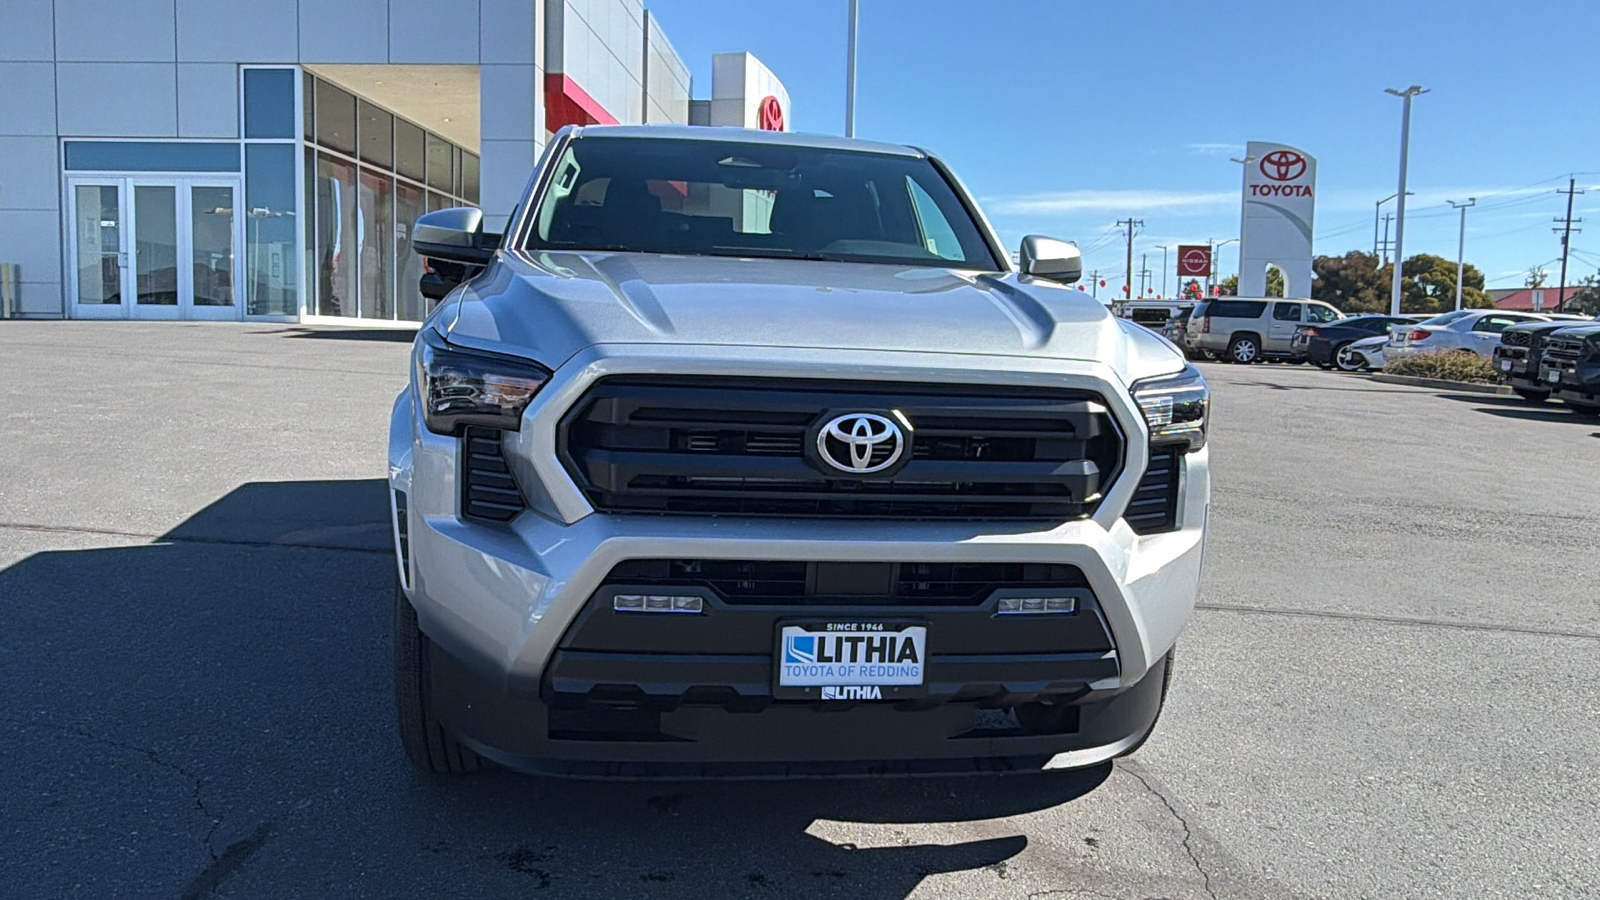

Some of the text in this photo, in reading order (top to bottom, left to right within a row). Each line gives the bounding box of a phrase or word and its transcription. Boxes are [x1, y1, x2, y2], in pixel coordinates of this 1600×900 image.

[1250, 185, 1312, 197] TOYOTA
[826, 623, 884, 631] SINCE 1946
[817, 636, 919, 664] LITHIA
[785, 665, 919, 677] TOYOTA OF REDDING
[835, 686, 882, 700] LITHIA
